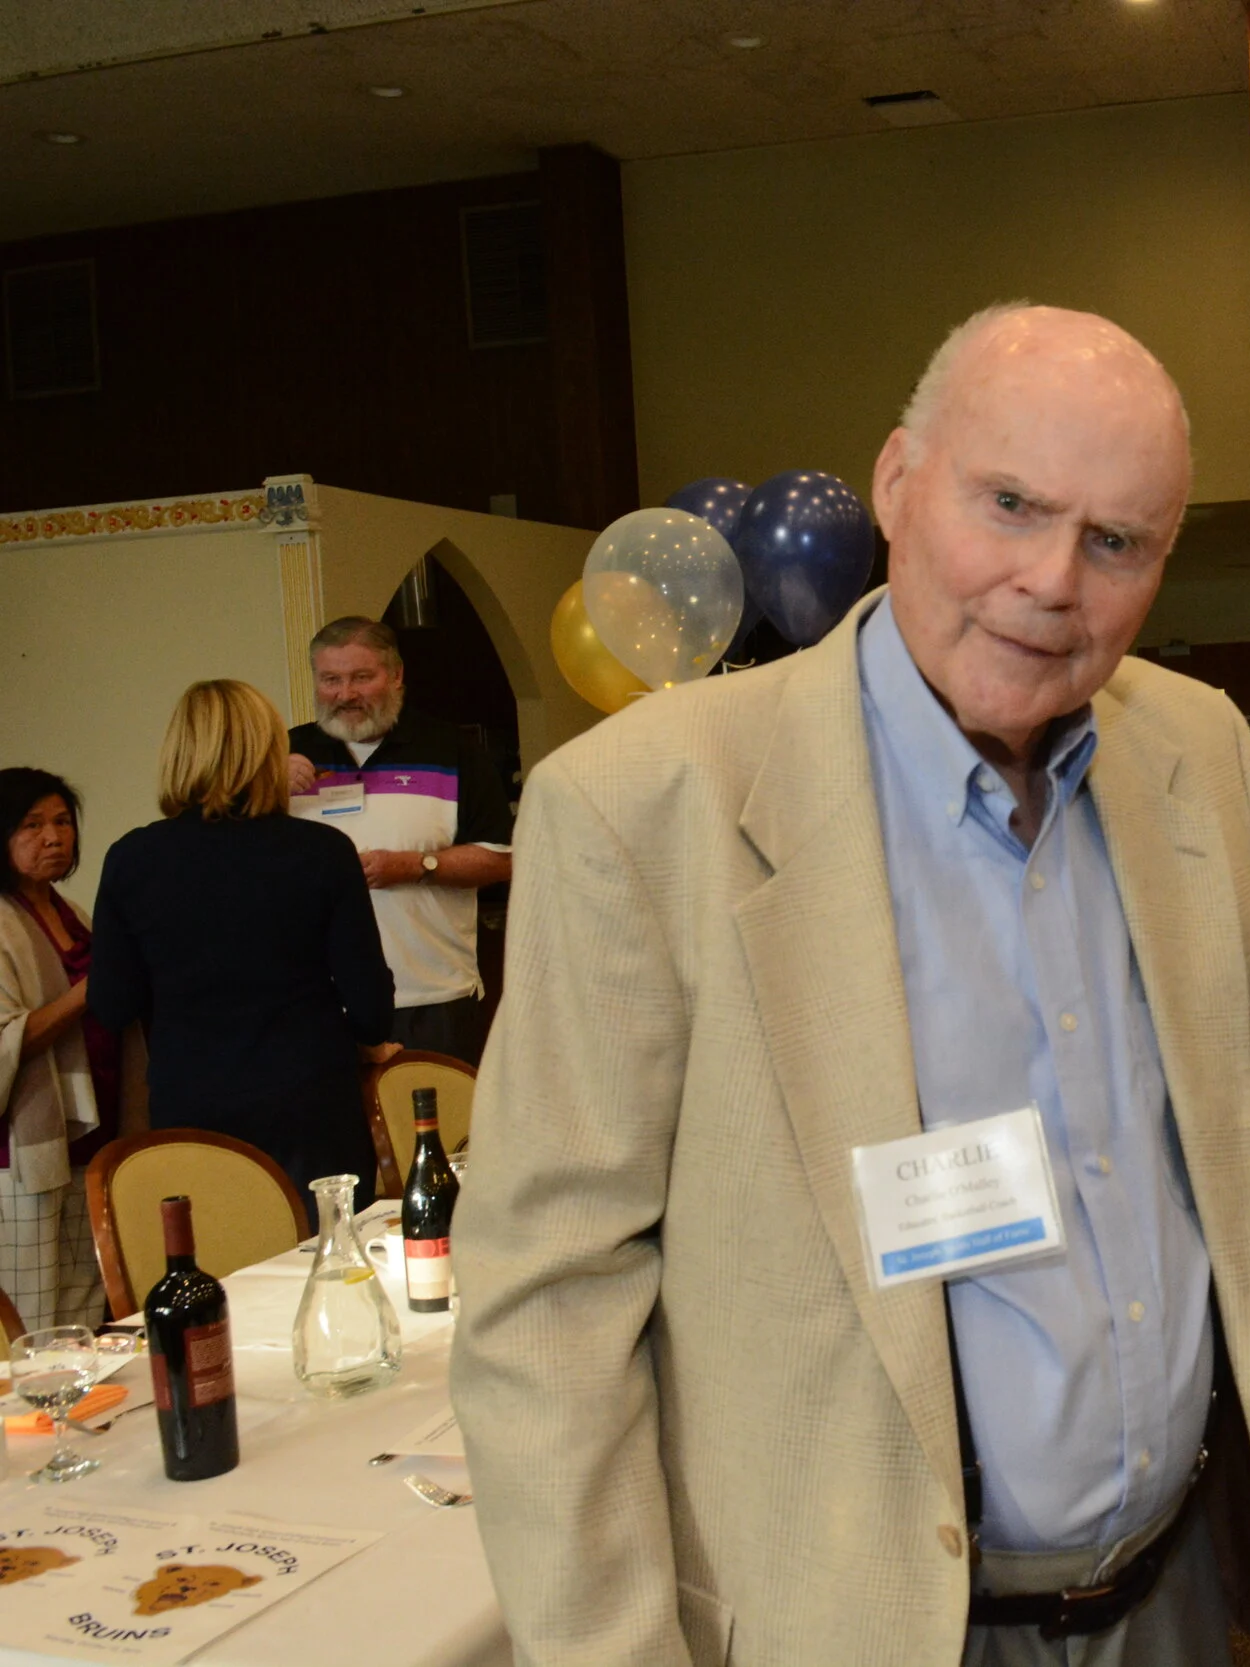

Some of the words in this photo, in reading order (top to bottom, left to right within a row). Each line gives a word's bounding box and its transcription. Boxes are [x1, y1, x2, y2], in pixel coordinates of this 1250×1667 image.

[156, 1544, 204, 1560] ST.
[216, 1542, 299, 1577] JOSEPH
[68, 1612, 172, 1642] BRUINS
